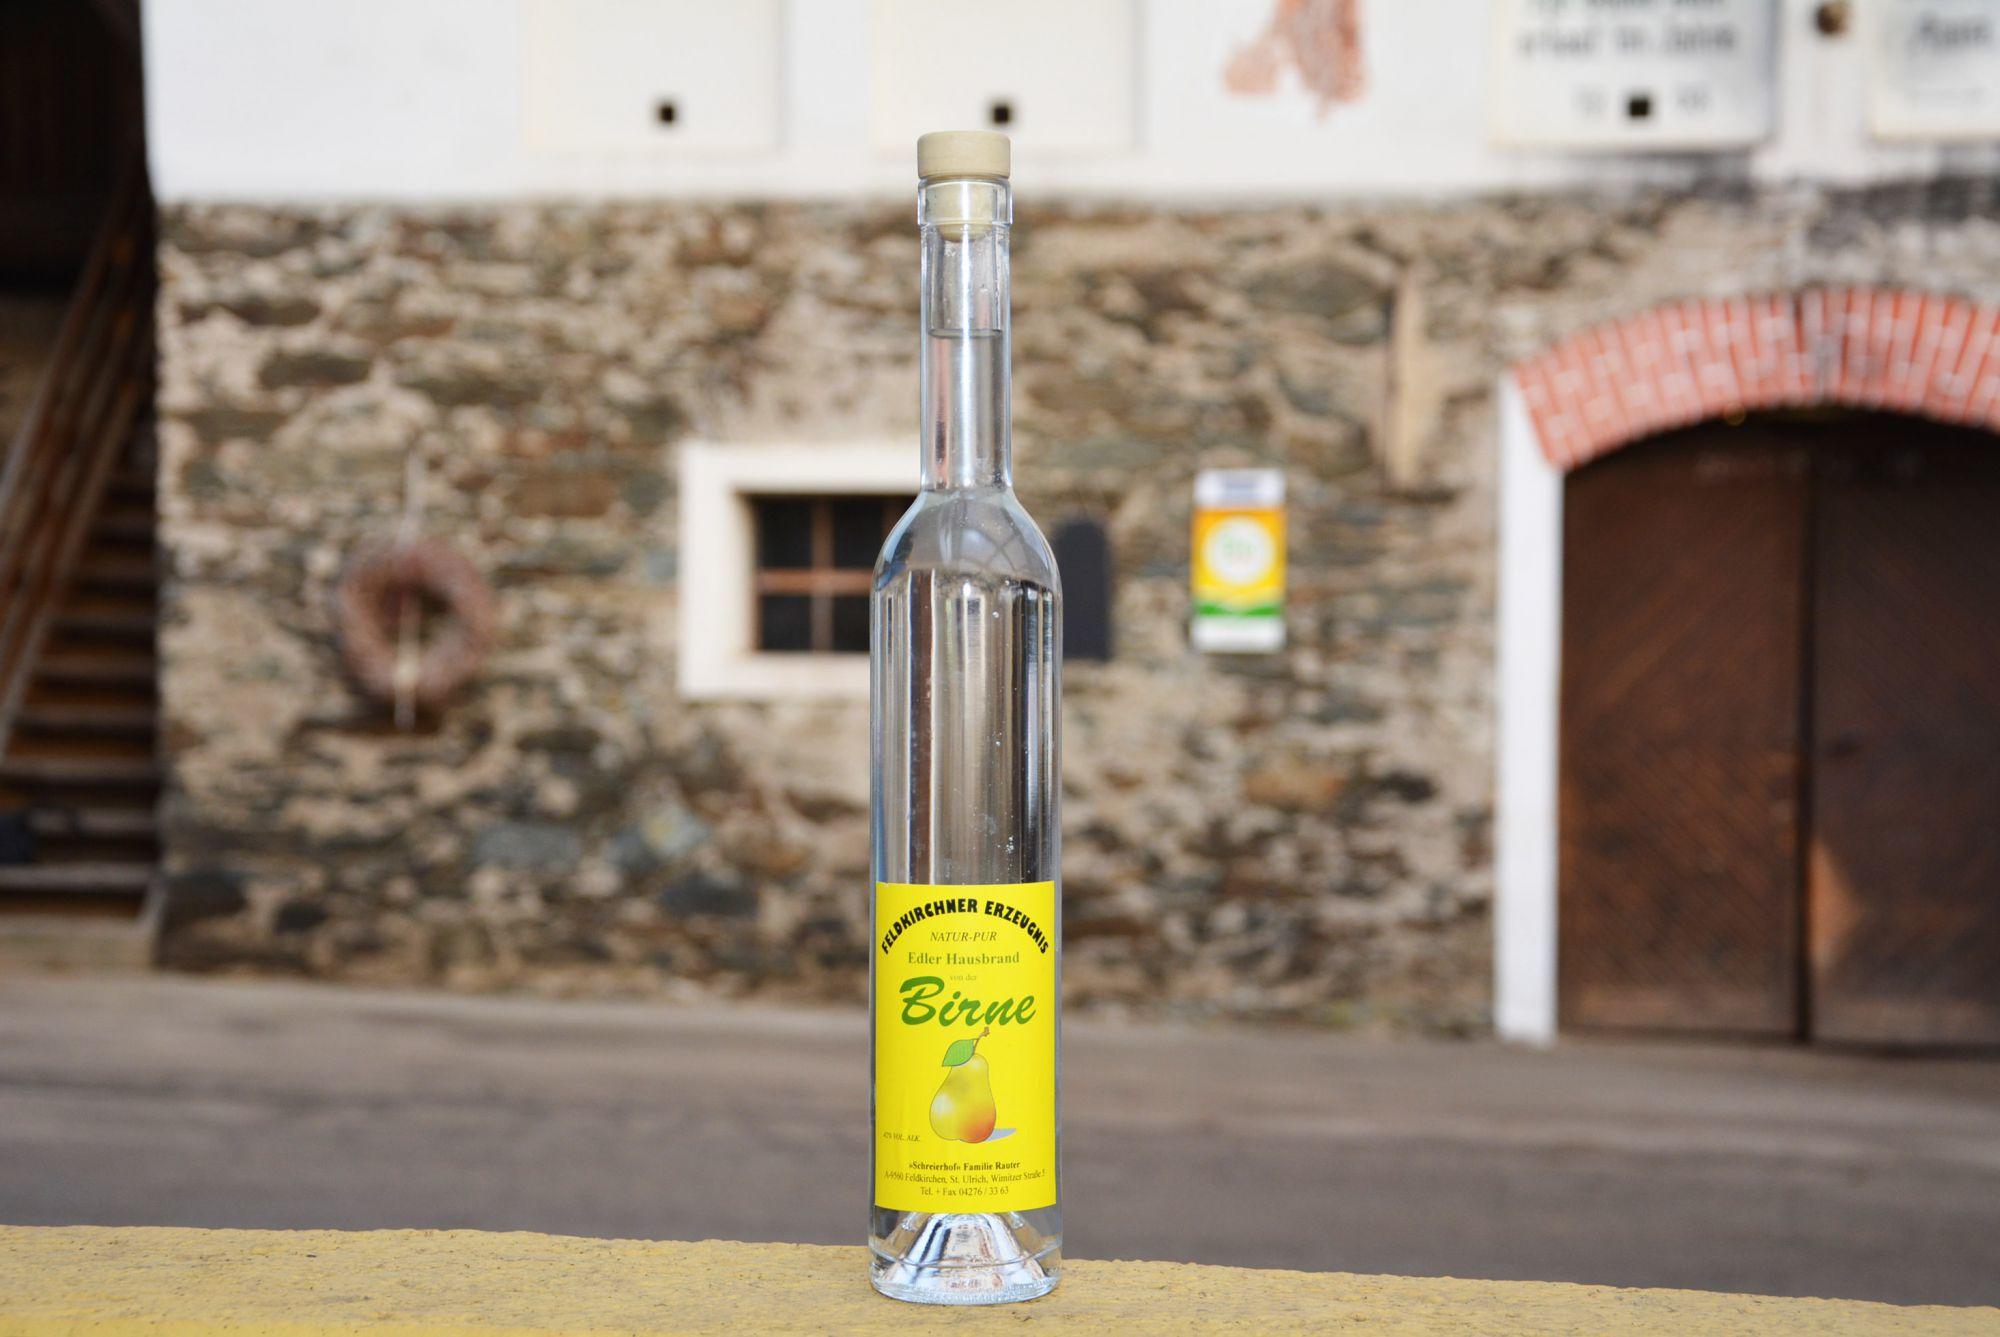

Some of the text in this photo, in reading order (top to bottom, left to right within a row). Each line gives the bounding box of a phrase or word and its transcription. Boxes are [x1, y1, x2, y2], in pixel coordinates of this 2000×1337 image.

[881, 898, 1049, 955] FELDKIRCHNER ERZEUGNIS
[929, 931, 998, 942] NATUR-PUR
[908, 951, 1020, 965] Edler Hausbrand
[899, 976, 1037, 1027] Birne
[963, 1161, 993, 1171] Familie
[995, 1161, 1021, 1170] Rauter
[920, 1187, 933, 1196] Tel.
[943, 1188, 957, 1196] Fax
